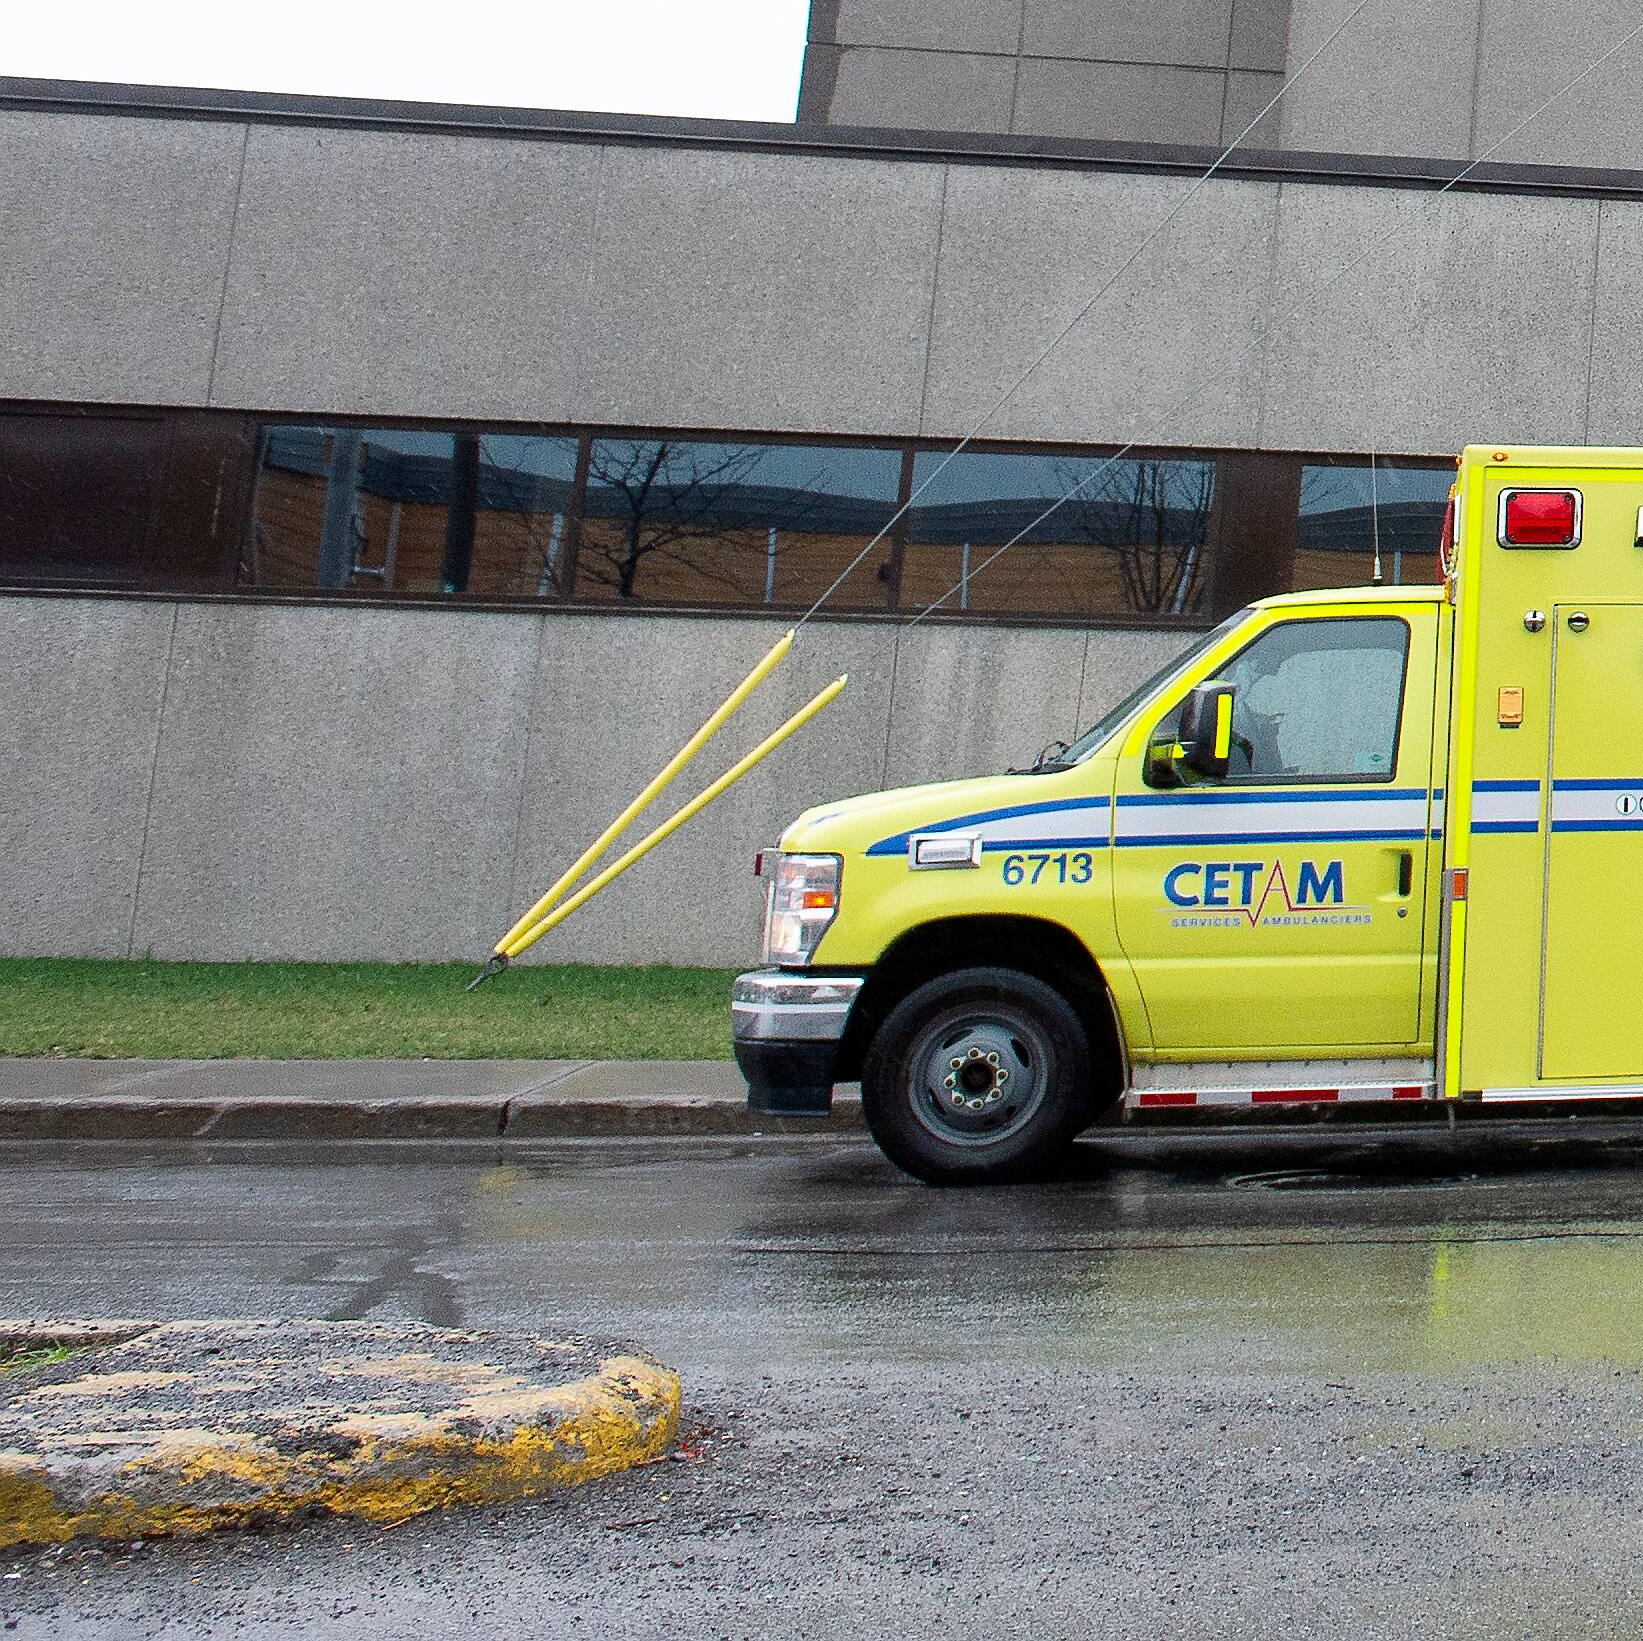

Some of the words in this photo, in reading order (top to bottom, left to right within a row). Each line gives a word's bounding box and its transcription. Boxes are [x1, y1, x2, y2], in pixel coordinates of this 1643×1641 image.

[1003, 852, 1092, 885] 6713
[1163, 860, 1344, 907] CETAM
[1171, 917, 1241, 928] SERVICES
[1261, 914, 1373, 926] AMBULANCIERS
